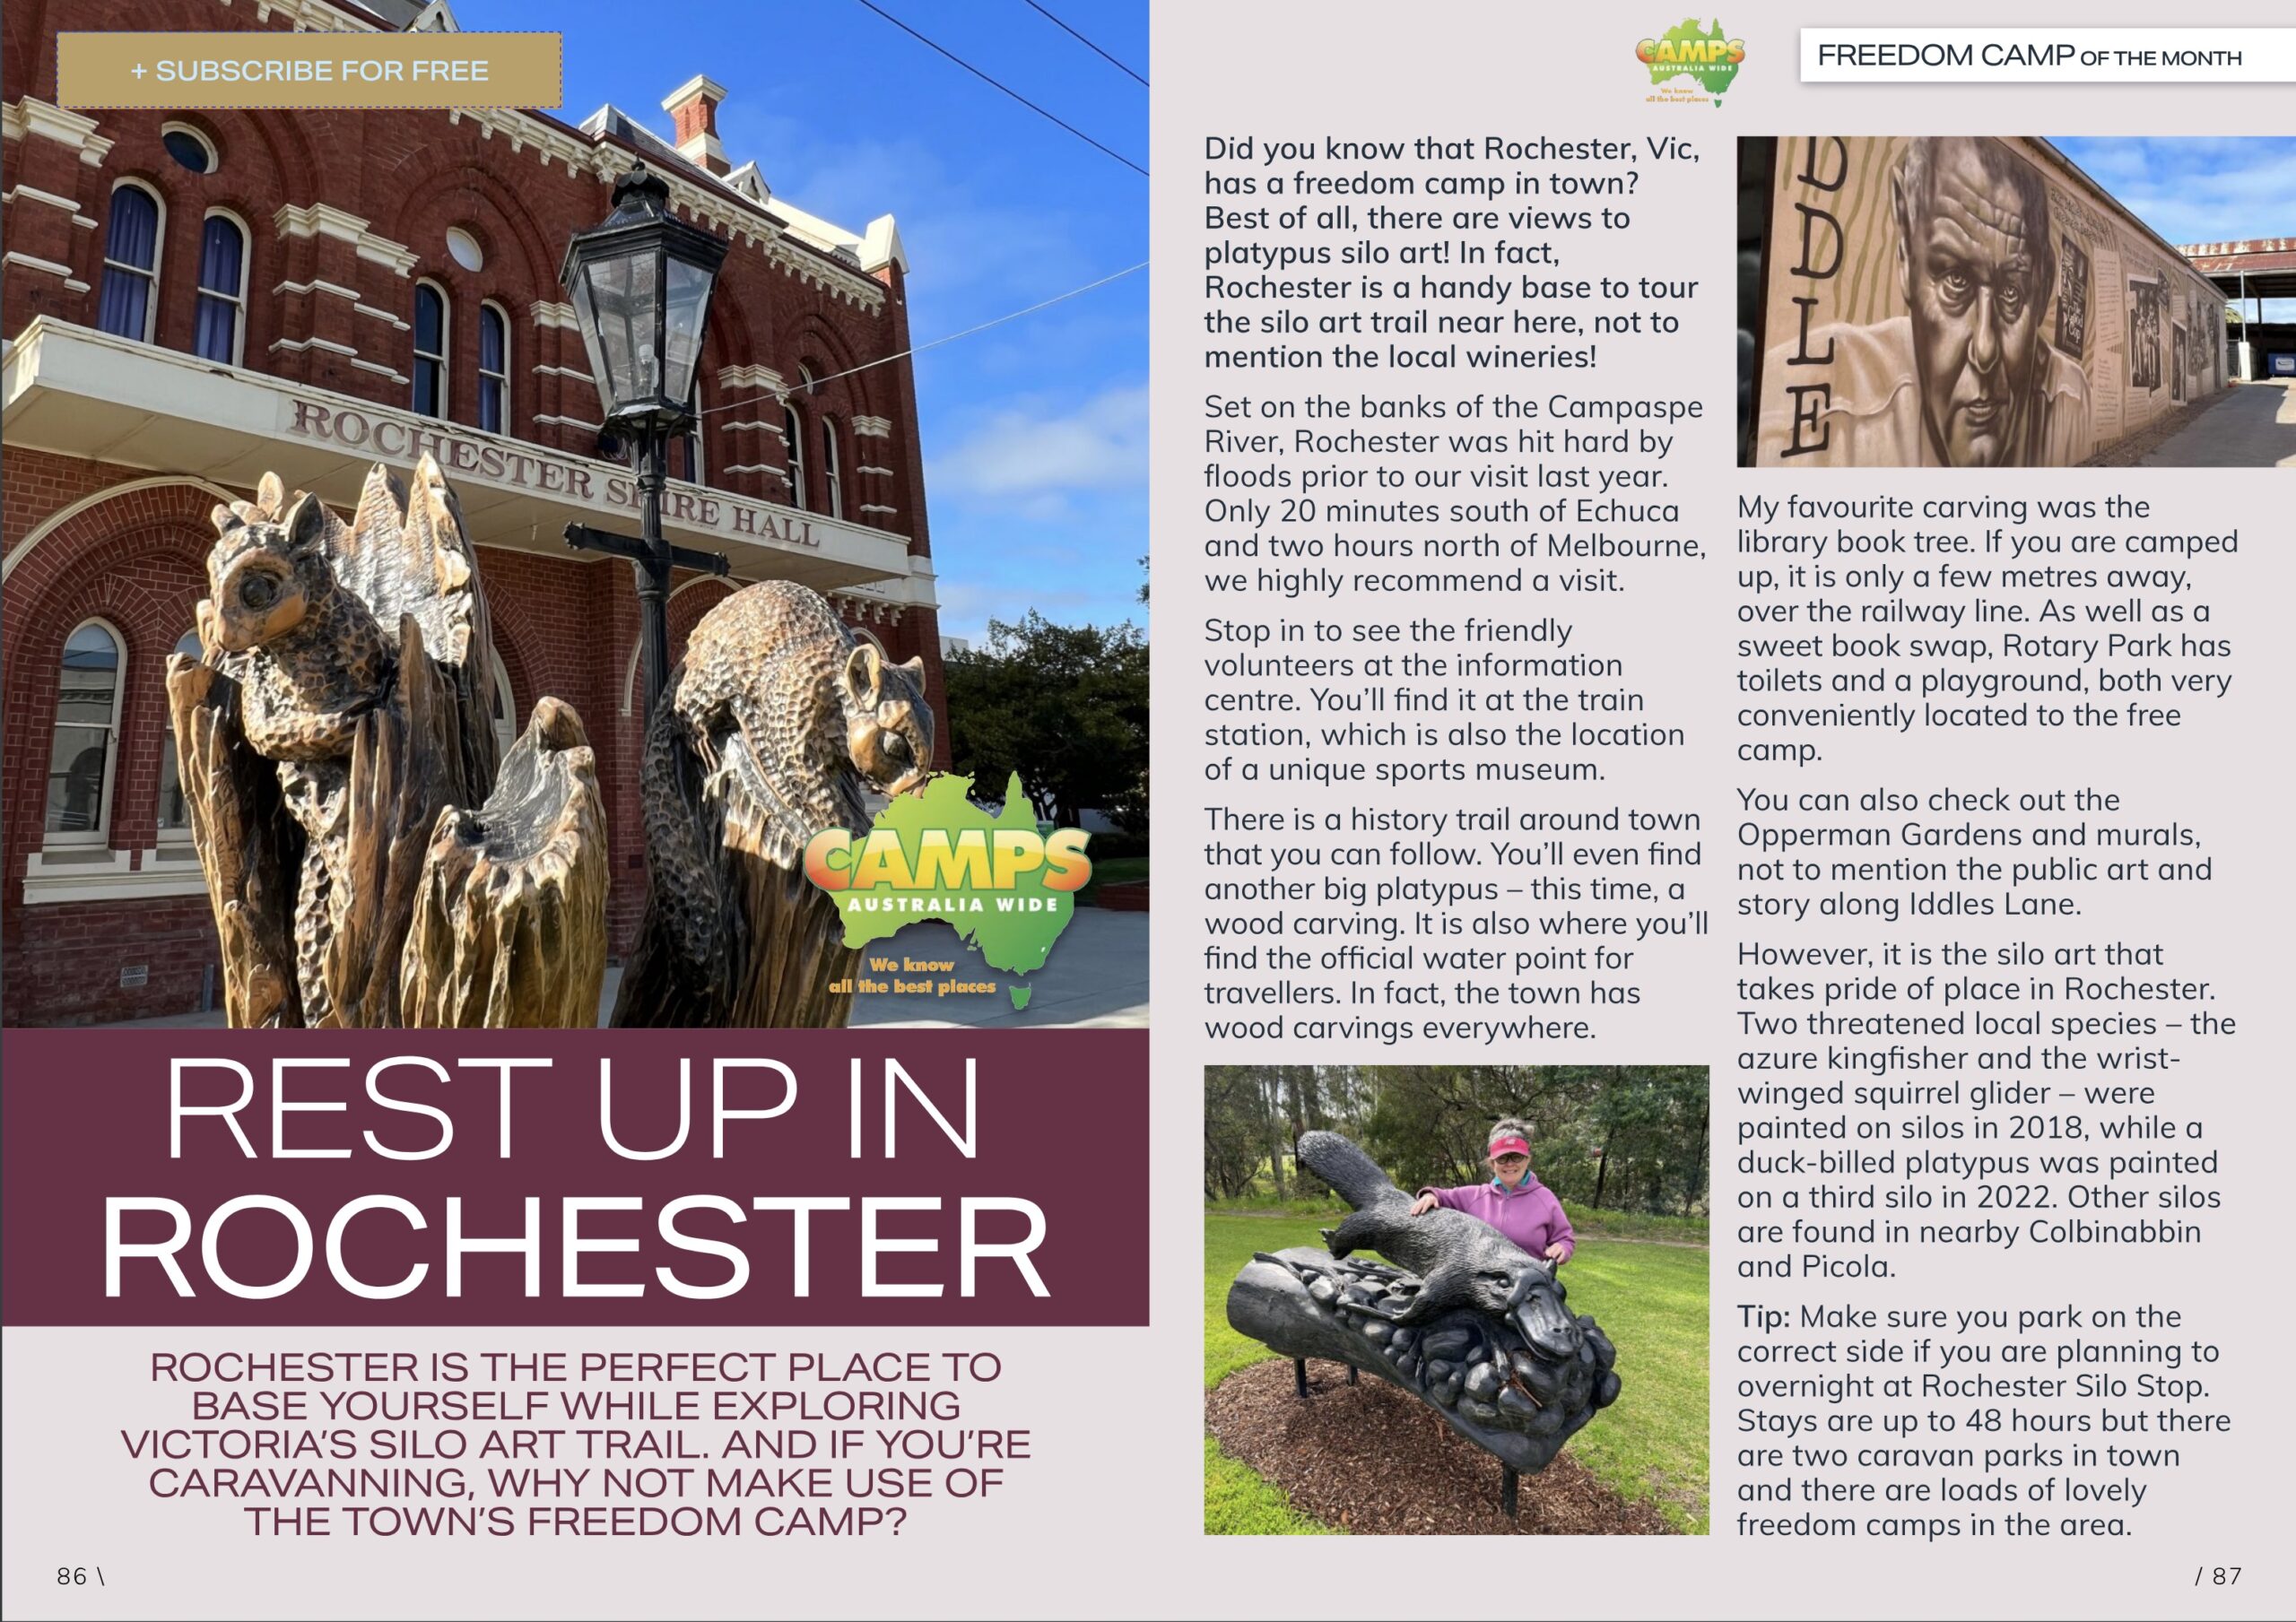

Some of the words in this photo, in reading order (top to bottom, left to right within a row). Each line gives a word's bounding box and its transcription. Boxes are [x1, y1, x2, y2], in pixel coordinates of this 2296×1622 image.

[1636, 38, 1746, 65] CAMPS
[1819, 43, 1973, 66] FREEDOM
[1981, 43, 2075, 66] CAMP
[2081, 51, 2109, 65] OF
[2114, 51, 2156, 65] THE
[2162, 51, 2241, 65] MONTH
[1206, 135, 1253, 160] Did
[1263, 143, 1314, 166] you
[1326, 135, 1405, 160] know
[1413, 135, 1474, 160] that
[1485, 135, 1637, 163] Rochester,
[1647, 136, 1699, 163] Vic,
[1205, 240, 1331, 271] platypus
[1342, 240, 1389, 264] silo
[1400, 240, 1449, 264] art!
[1461, 240, 1484, 264] In
[1494, 239, 1559, 267] fact,
[1205, 344, 1322, 368] mention
[1332, 344, 1378, 368] the
[1390, 344, 1456, 368] local
[1466, 344, 1596, 368] wineries!
[1206, 429, 1283, 455] River,
[1296, 429, 1439, 453] Rochester
[1448, 436, 1508, 453] was
[1519, 429, 1554, 453] hit
[1565, 429, 1628, 453] hard
[1640, 429, 1674, 459] by
[291, 400, 594, 500] ROCHESTER
[732, 505, 821, 549] HALL
[1205, 498, 1270, 529] Only
[1281, 499, 1316, 523] 20
[1327, 499, 1439, 522] minutes
[1450, 498, 1528, 523] south
[1540, 498, 1567, 522] of
[1578, 498, 1678, 522] Echuca
[1205, 757, 1232, 780] of
[1242, 763, 1257, 780] a
[1270, 758, 1365, 787] unique
[1376, 759, 1465, 787] sports
[1476, 763, 1605, 780] museum.
[1738, 822, 1890, 853] Opperman
[1901, 821, 2022, 846] Gardens
[2032, 821, 2085, 846] and
[2098, 821, 2200, 849] murals,
[803, 826, 1092, 892] CAMPS
[848, 898, 984, 912] AUSTRALIA
[996, 898, 1058, 912] WIDE
[1205, 876, 1316, 900] another
[1325, 876, 1366, 906] big
[1378, 876, 1498, 906] platypus
[1530, 876, 1581, 900] this
[1590, 877, 1658, 903] time,
[1668, 883, 1684, 899] a
[1738, 894, 1810, 922] story
[1820, 891, 1899, 922] along
[1911, 891, 1994, 915] Iddles
[2005, 892, 2081, 915] Lane.
[869, 958, 899, 972] We
[903, 958, 955, 972] know
[829, 979, 853, 993] all
[857, 979, 889, 993] the
[894, 979, 933, 993] best
[938, 979, 996, 997] places
[1205, 1015, 1283, 1039] wood
[1293, 1016, 1413, 1045] carvings
[1423, 1015, 1596, 1045] everywhere.
[1736, 1011, 1797, 1035] Two
[1806, 1010, 1964, 1035] threatened
[1976, 1010, 2040, 1035] local
[2051, 1011, 2156, 1041] species
[2190, 1010, 2236, 1035] the
[170, 1056, 552, 1160] REST
[601, 1058, 797, 1160] UP
[851, 1058, 976, 1158] IN
[1739, 1115, 1846, 1145] painted
[1857, 1122, 1890, 1139] on
[1901, 1115, 1964, 1139] silos
[1974, 1115, 1997, 1139] in
[2010, 1115, 2089, 1141] 2018,
[2100, 1115, 2176, 1139] while
[2187, 1122, 2202, 1139] a
[106, 1194, 1051, 1299] ROCHESTER
[1738, 1226, 1783, 1243] are
[1792, 1219, 1874, 1243] found
[1885, 1219, 1909, 1243] in
[1920, 1219, 2020, 1250] nearby
[2030, 1219, 2200, 1243] Colbinabbin
[1738, 1253, 1791, 1278] and
[1804, 1253, 1895, 1278] Picola.
[152, 1352, 419, 1382] ROCHESTER
[432, 1352, 468, 1382] IS
[480, 1353, 567, 1382] THE
[581, 1352, 777, 1382] PERFECT
[790, 1352, 930, 1382] PLACE
[942, 1352, 1001, 1382] TO
[1738, 1374, 1874, 1404] overnight
[1883, 1375, 1912, 1397] at
[1923, 1373, 2066, 1397] Rochester
[2076, 1374, 2126, 1397] Silo
[2137, 1374, 2209, 1404] Stop.
[194, 1391, 308, 1420] BASE
[319, 1391, 549, 1420] YOURSELF
[560, 1392, 700, 1420] WHILE
[715, 1391, 960, 1421] EXPLORING
[120, 1429, 357, 1460] VICTORIA’S
[370, 1429, 466, 1460] SILO
[479, 1430, 566, 1459] ART
[576, 1430, 709, 1459] TRAIL.
[721, 1430, 816, 1459] AND
[831, 1430, 865, 1459] IF
[875, 1429, 1031, 1460] YOU’RE
[150, 1468, 474, 1501] CARAVANNING,
[488, 1469, 591, 1497] WHY
[604, 1468, 695, 1497] NOT
[708, 1469, 832, 1497] MAKE
[847, 1468, 933, 1497] USE
[945, 1468, 1004, 1497] OF
[244, 1507, 330, 1536] THE
[342, 1506, 515, 1536] TOWN’S
[529, 1506, 740, 1536] FREEDOM
[755, 1506, 907, 1536] CAMP?
[1736, 1512, 1856, 1536] freedom
[1866, 1519, 1961, 1542] camps
[1971, 1513, 1995, 1536] in
[2005, 1512, 2050, 1536] the
[2060, 1519, 2131, 1536] area.
[57, 1567, 86, 1585] 86
[2213, 1567, 2241, 1585] 87
